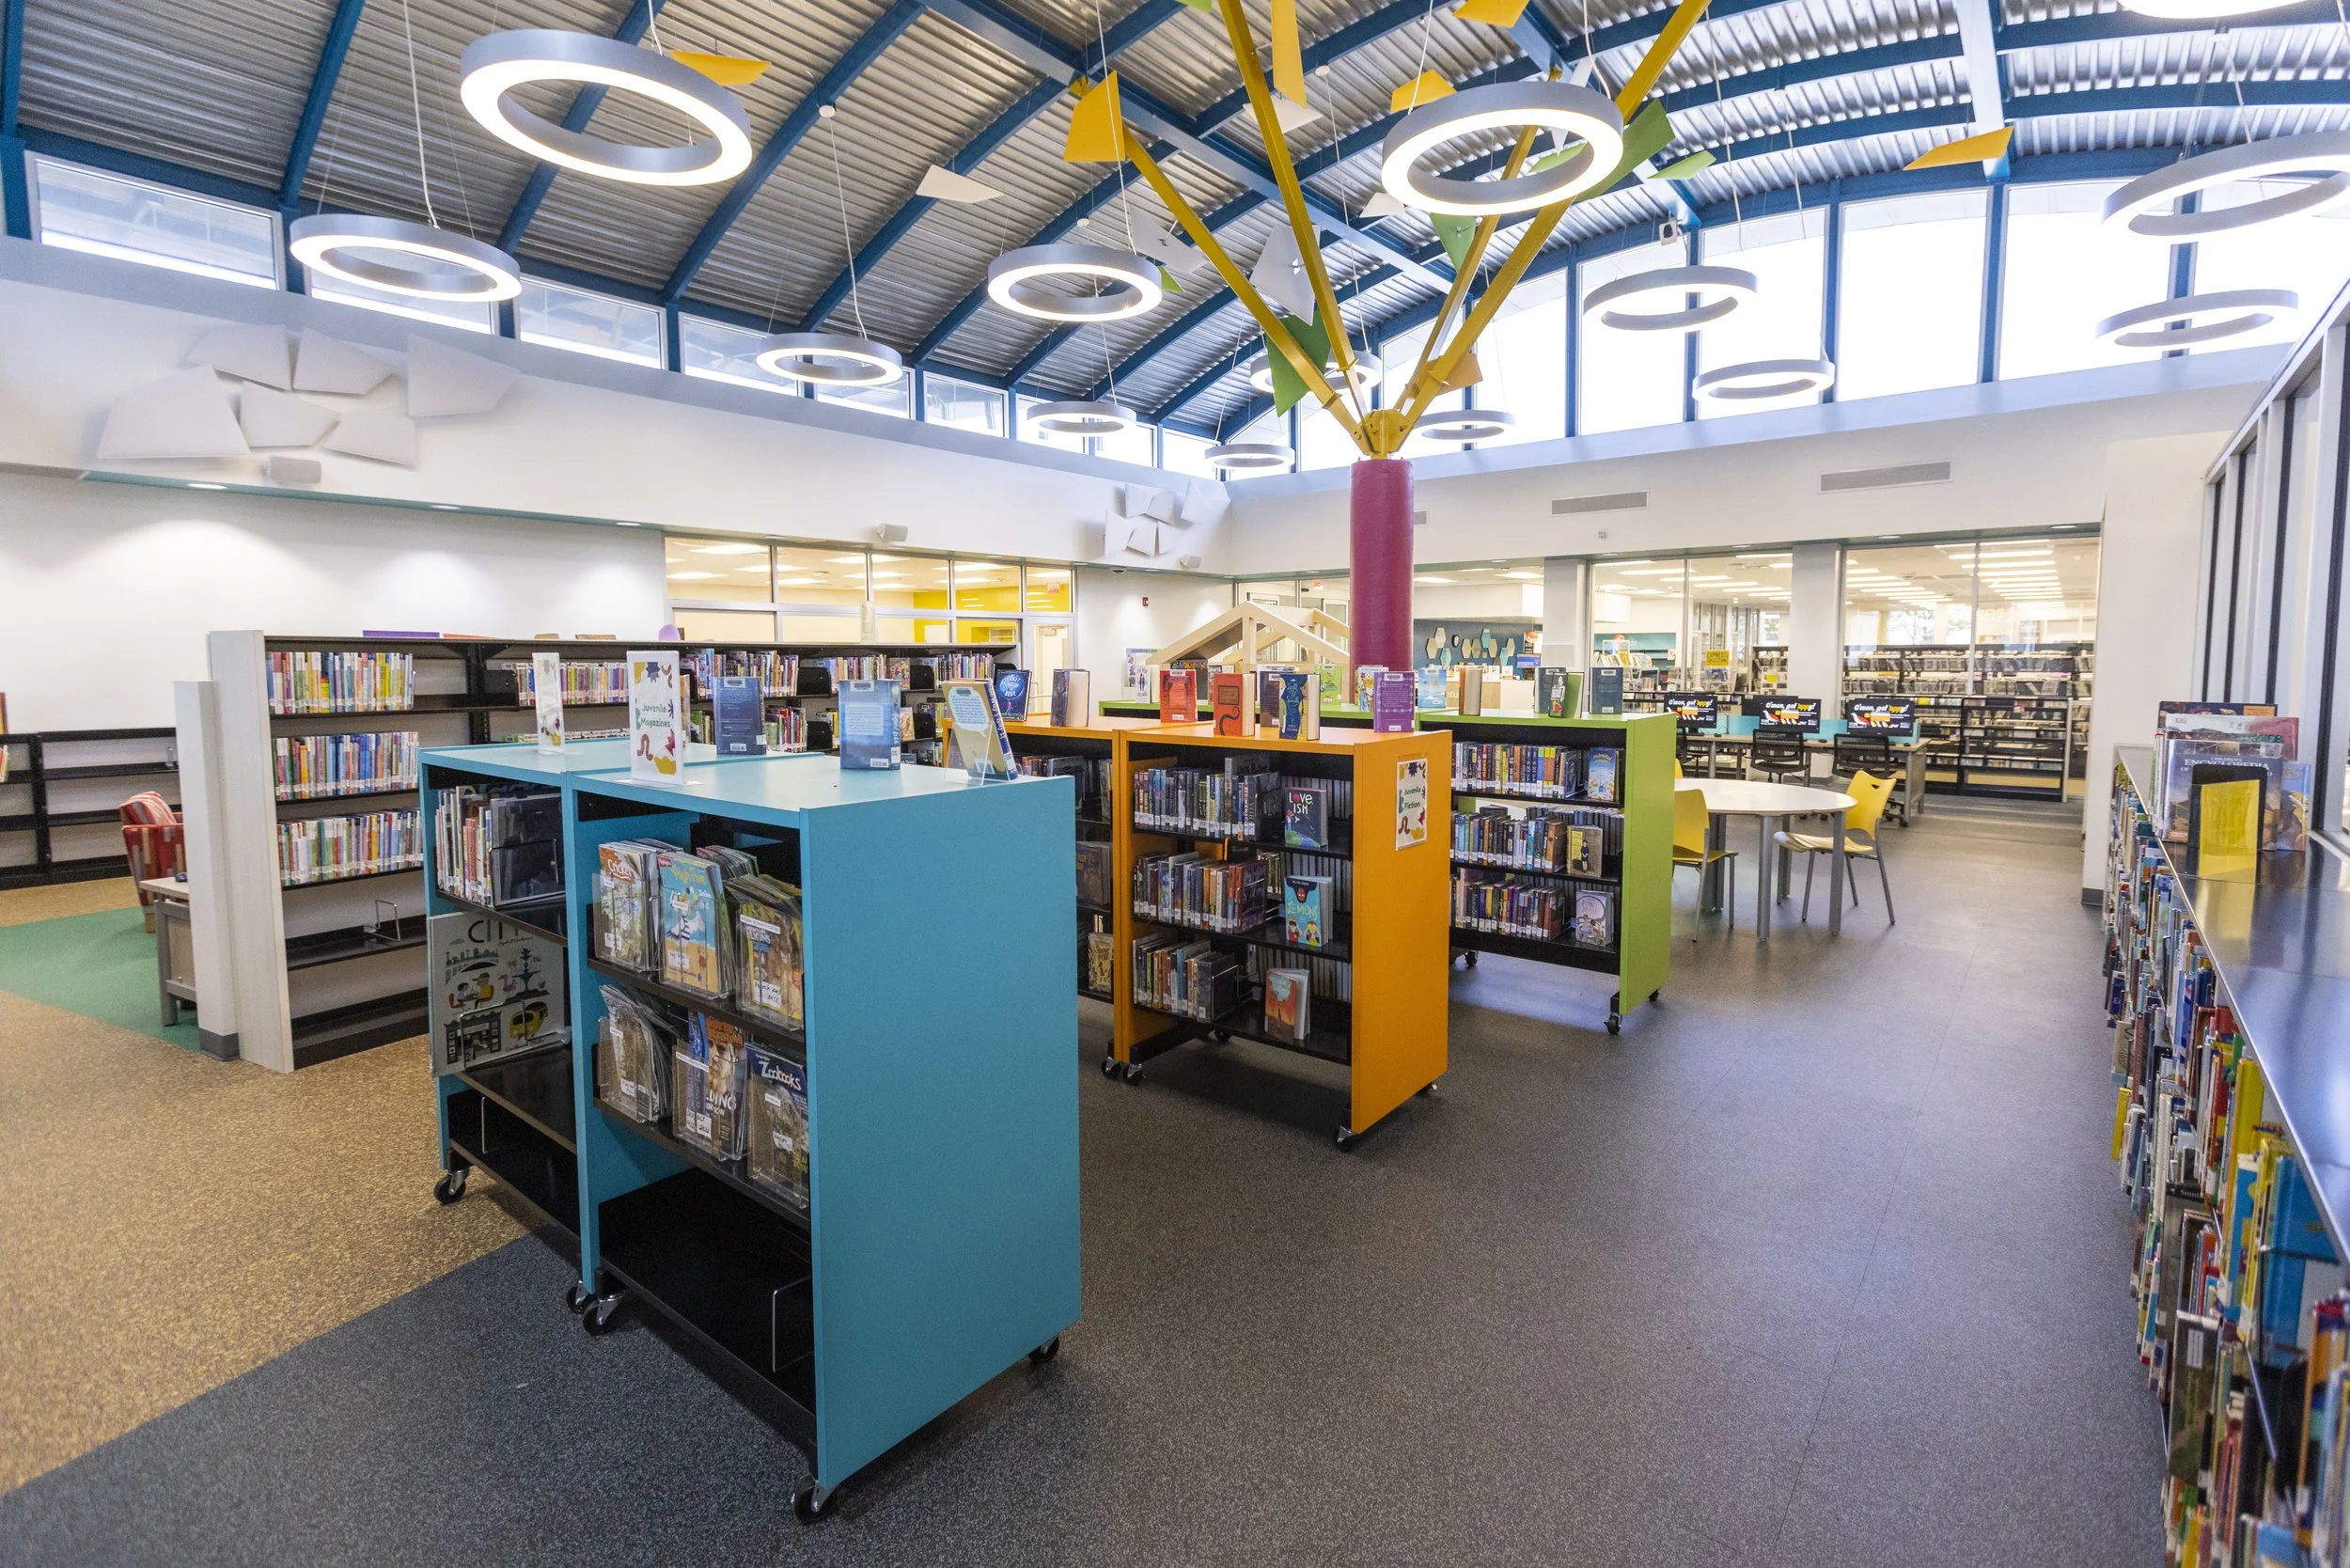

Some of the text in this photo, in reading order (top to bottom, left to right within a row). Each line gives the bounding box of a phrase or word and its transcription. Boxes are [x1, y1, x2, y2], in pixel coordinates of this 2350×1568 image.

[642, 703, 666, 713] Juvenile
[640, 717, 671, 729] Magazines
[1403, 786, 1421, 795] Juvenile
[1293, 803, 1308, 815] ISH
[1403, 801, 1420, 809] Fiction
[759, 1060, 802, 1090] Zoobooks
